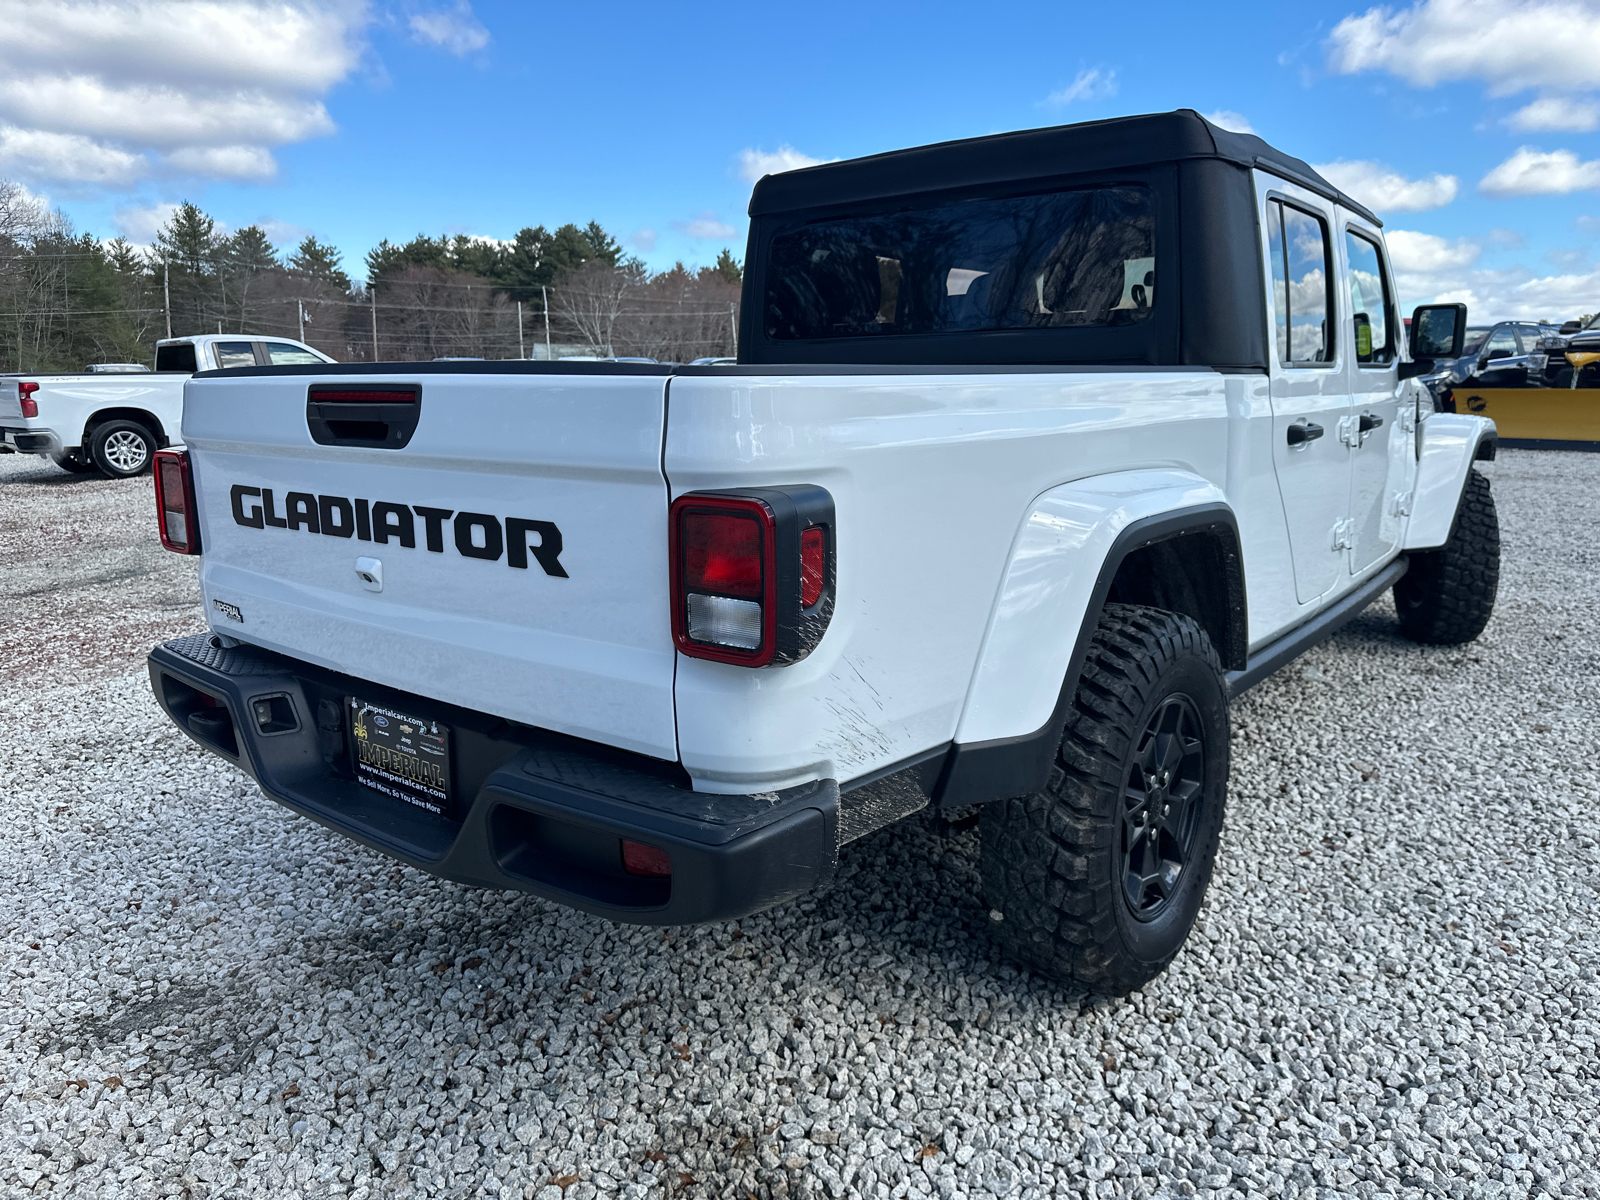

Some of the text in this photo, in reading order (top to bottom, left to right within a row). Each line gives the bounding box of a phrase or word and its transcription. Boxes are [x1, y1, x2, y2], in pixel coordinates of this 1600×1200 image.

[230, 484, 569, 578] GLADIATOR
[364, 702, 423, 727] Imperialcars.com
[358, 738, 446, 791] IMPERIAL
[401, 745, 417, 755] TOYOTA
[357, 775, 367, 785] We
[367, 779, 377, 789] Sell
[392, 789, 400, 798] So
[400, 792, 411, 803] You
[411, 797, 426, 809] Save
[426, 802, 441, 814] More
